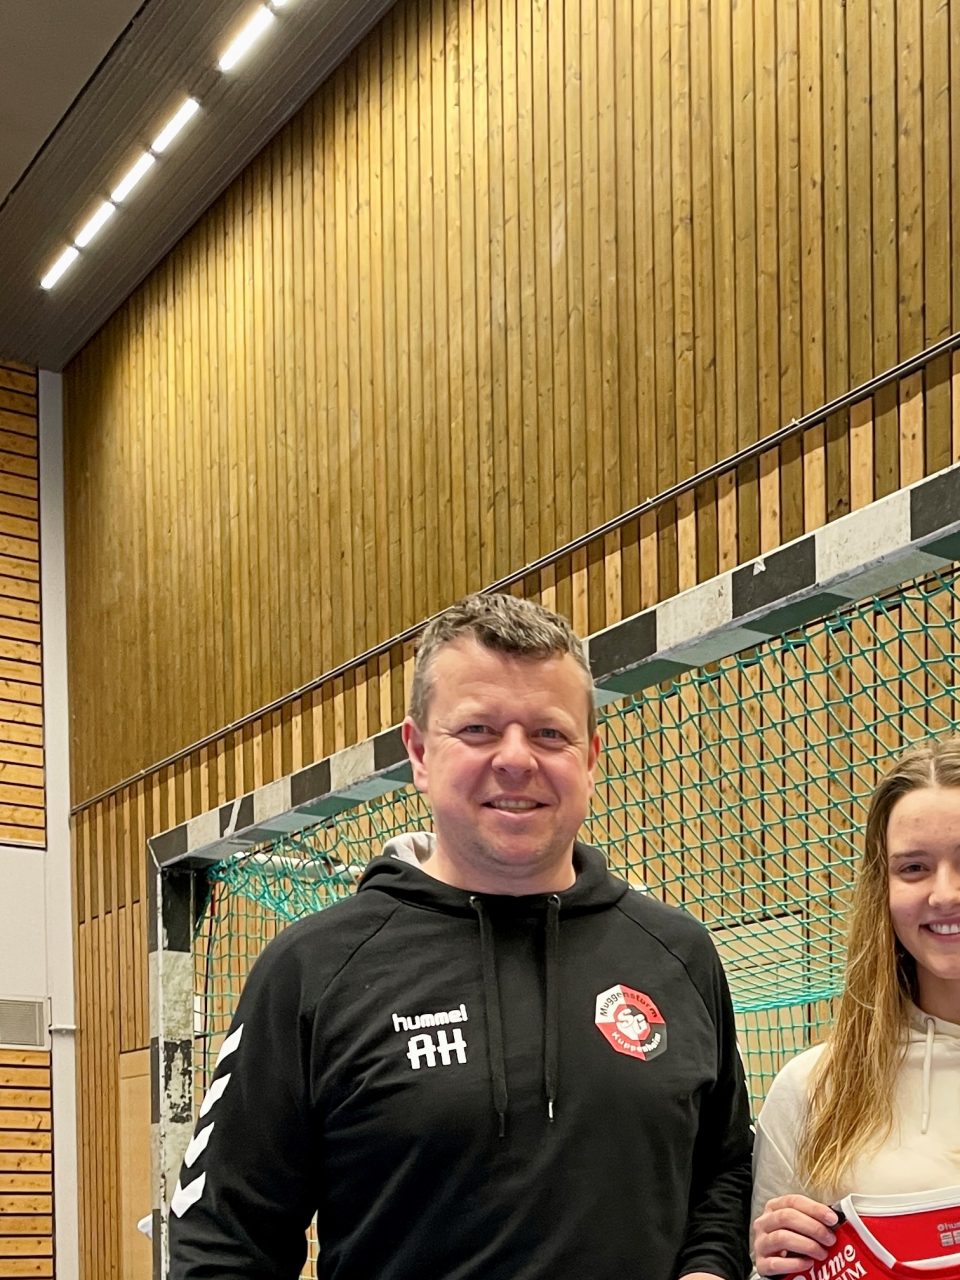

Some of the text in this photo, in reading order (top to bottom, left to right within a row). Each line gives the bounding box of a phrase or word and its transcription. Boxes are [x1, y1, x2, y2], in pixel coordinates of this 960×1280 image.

[392, 1003, 468, 1032] hummel
[599, 991, 658, 1018] Muggensturm
[615, 1008, 648, 1036] SG
[406, 1028, 467, 1070] AH
